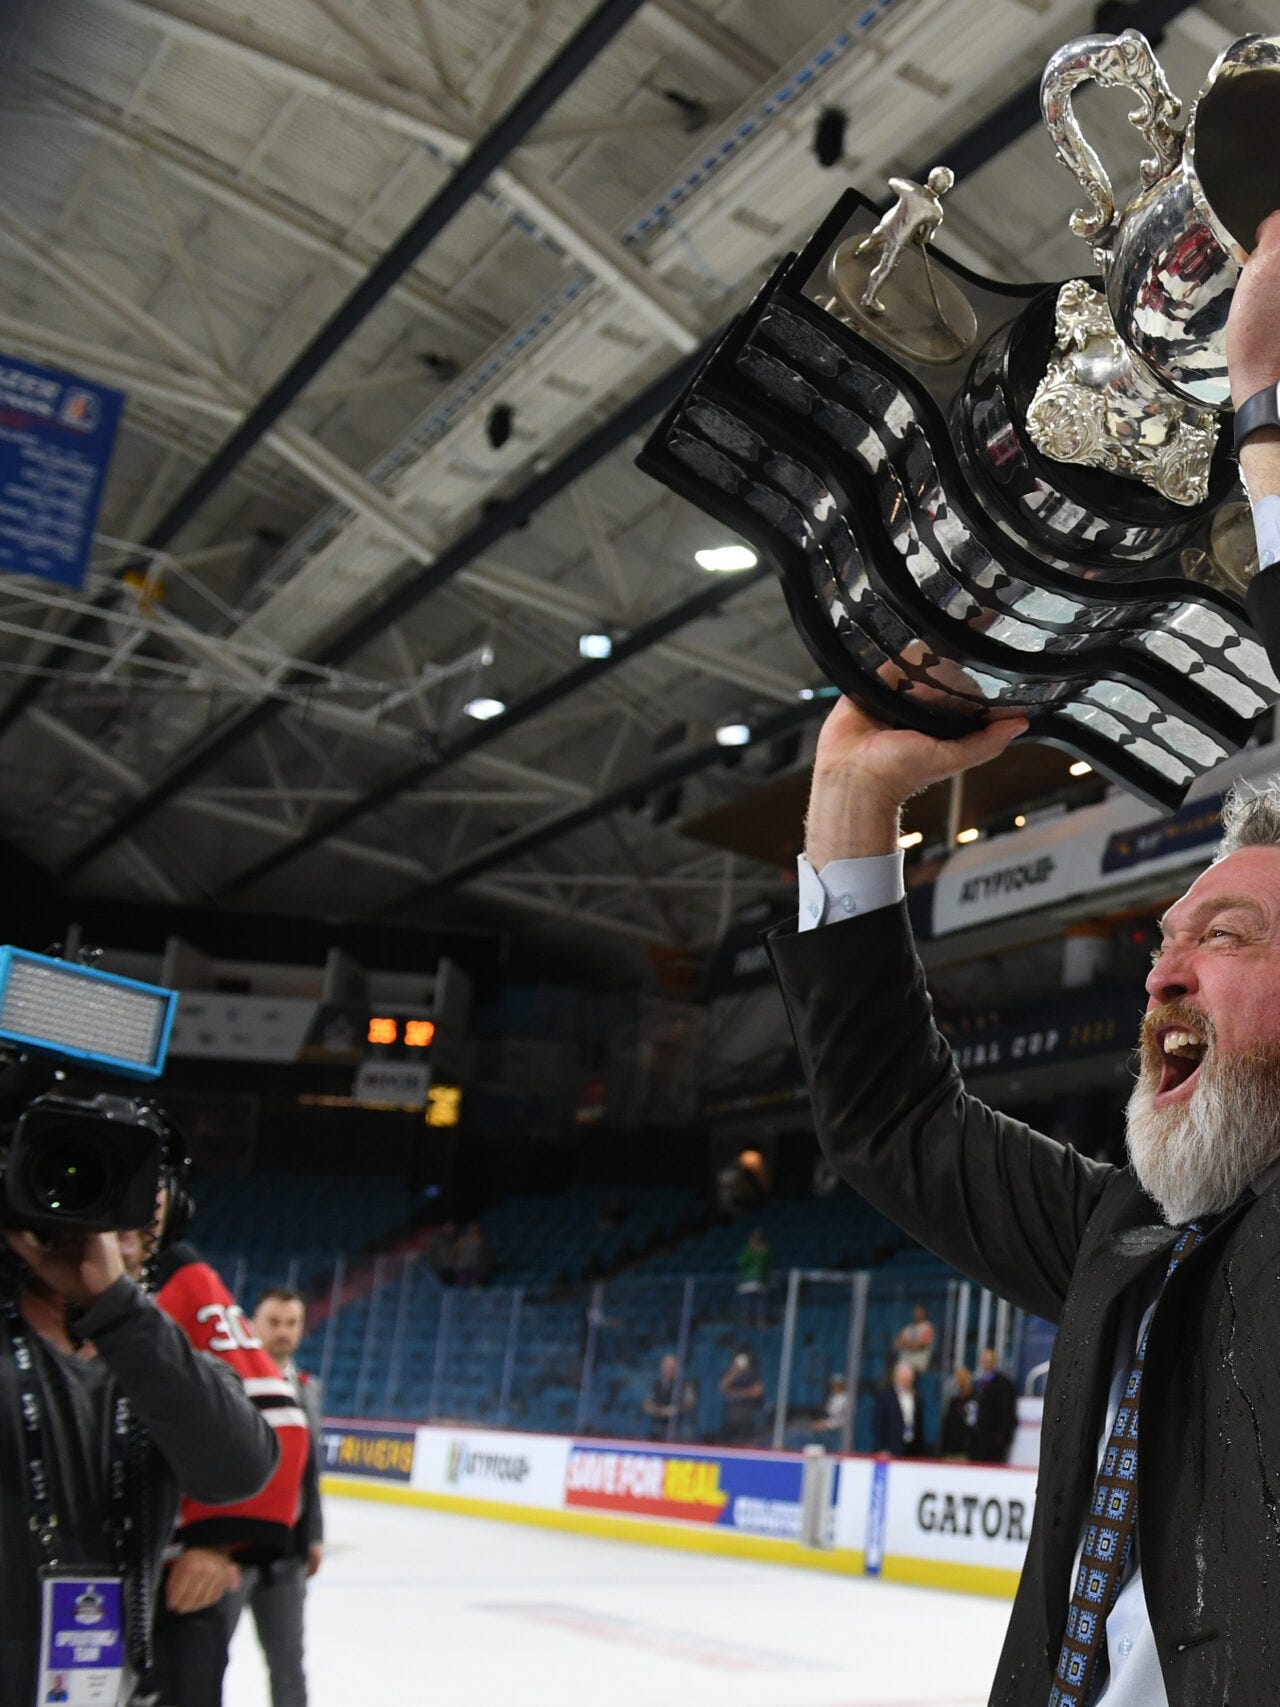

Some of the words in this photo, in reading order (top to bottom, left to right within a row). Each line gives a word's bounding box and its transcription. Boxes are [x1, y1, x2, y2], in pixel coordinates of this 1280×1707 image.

[196, 1303, 264, 1352] 30
[320, 1433, 415, 1473] TRIVERS
[917, 1491, 1033, 1542] GATOR
